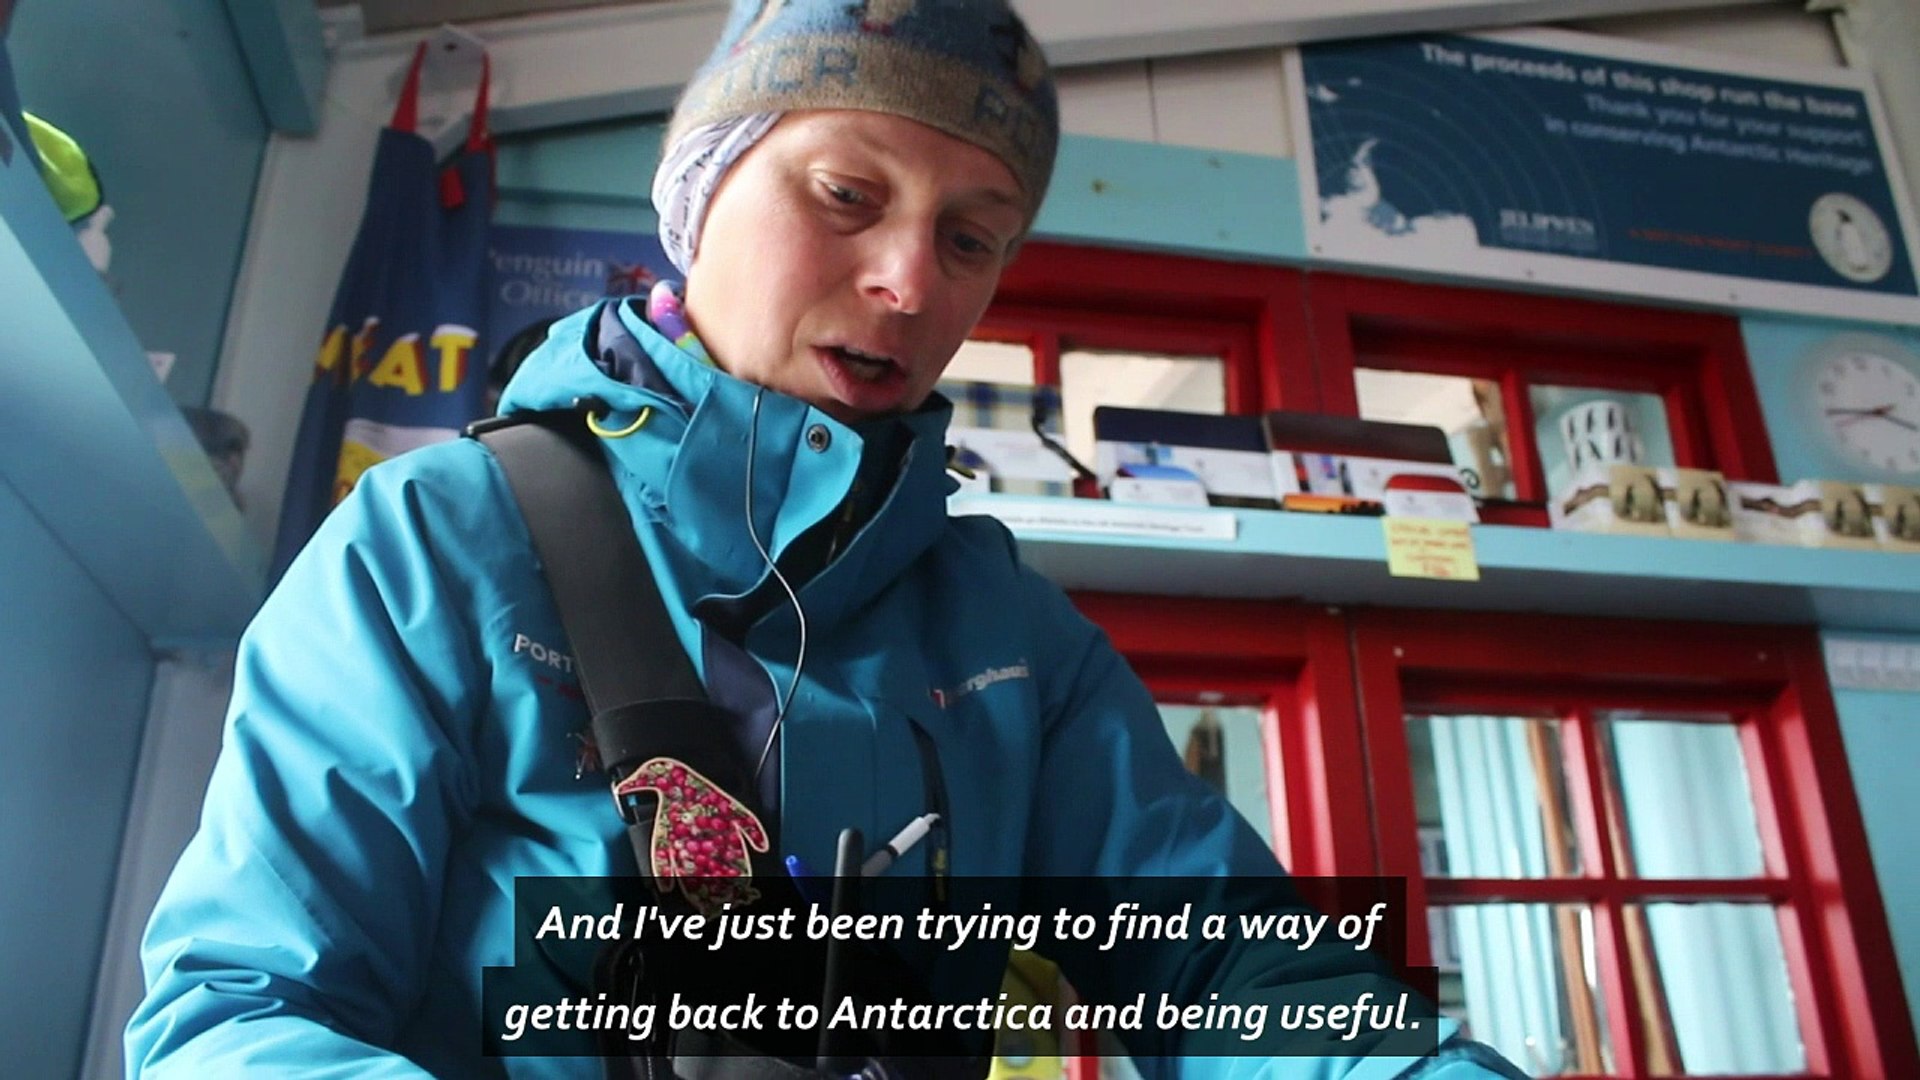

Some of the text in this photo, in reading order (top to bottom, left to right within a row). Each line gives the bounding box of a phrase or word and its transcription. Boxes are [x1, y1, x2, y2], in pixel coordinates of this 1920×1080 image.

[1421, 42, 1858, 118] The proceeds of this shop run the base
[1544, 114, 1874, 176] in conserving Antarctic Heritage
[1584, 93, 1868, 147] Thank you for your support
[487, 250, 603, 284] enguin
[514, 633, 574, 673] PORT
